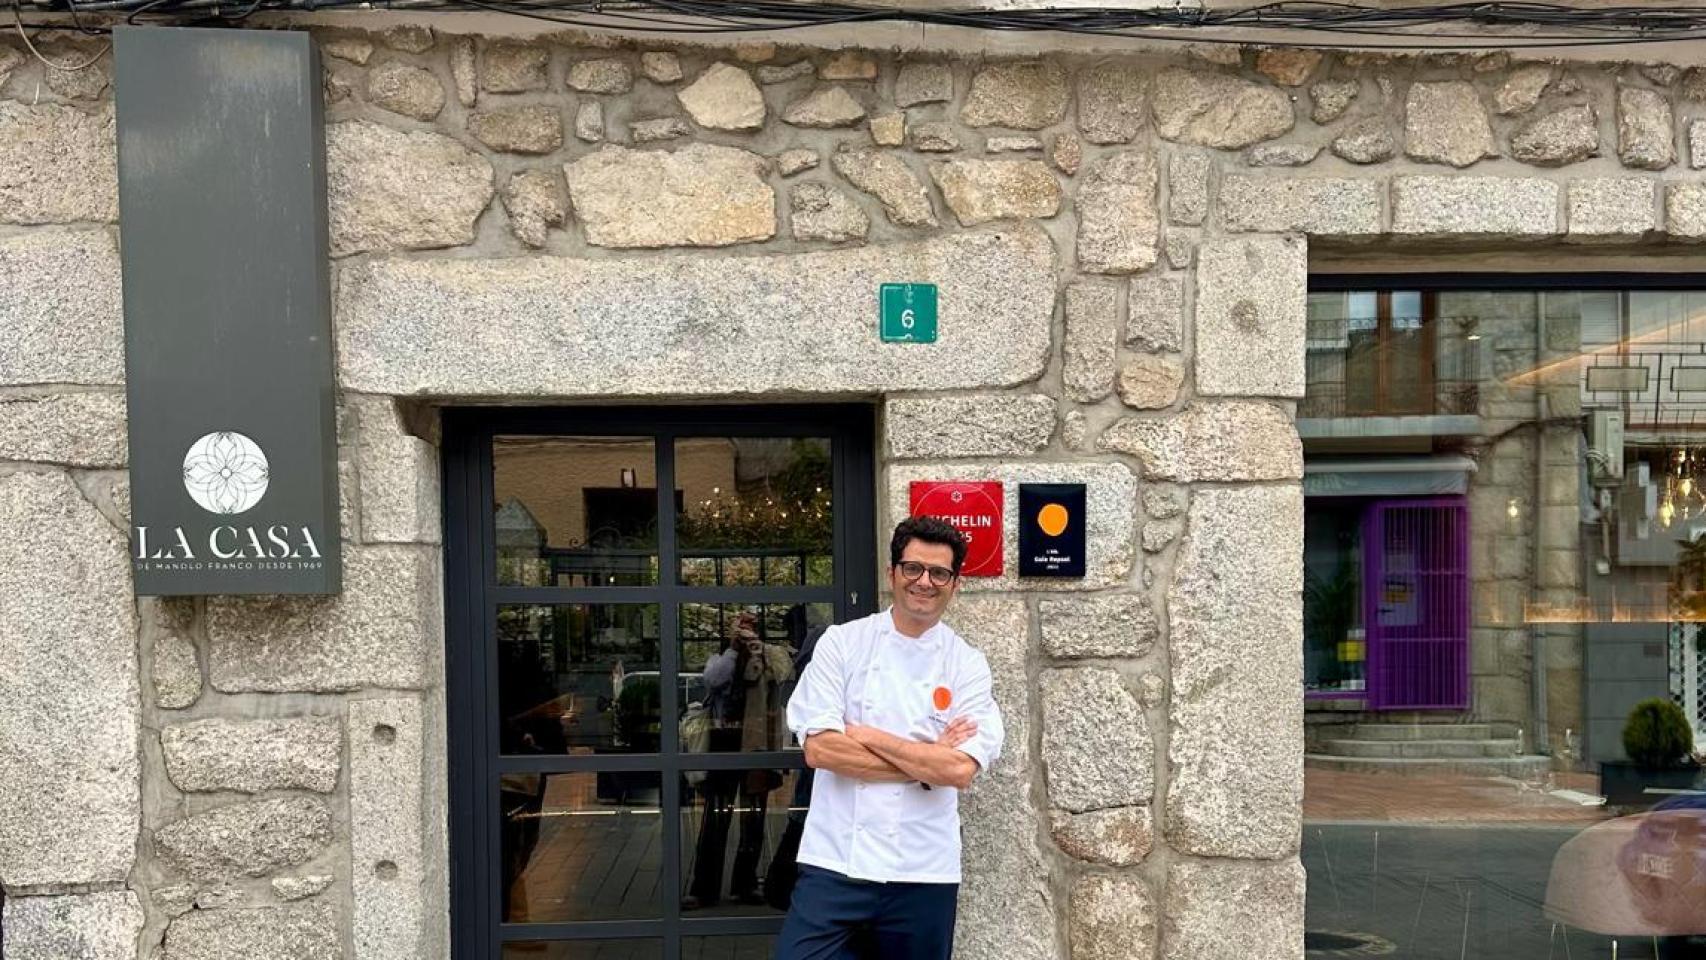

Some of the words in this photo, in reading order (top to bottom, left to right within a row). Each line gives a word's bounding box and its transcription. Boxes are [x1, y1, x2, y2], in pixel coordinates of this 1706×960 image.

[902, 309, 914, 329] 6
[135, 526, 196, 559] LA
[209, 525, 322, 559] CASA
[137, 562, 150, 570] DE
[156, 562, 203, 570] MANOLO
[208, 562, 253, 570] FRANCO
[259, 562, 293, 570] DESDE
